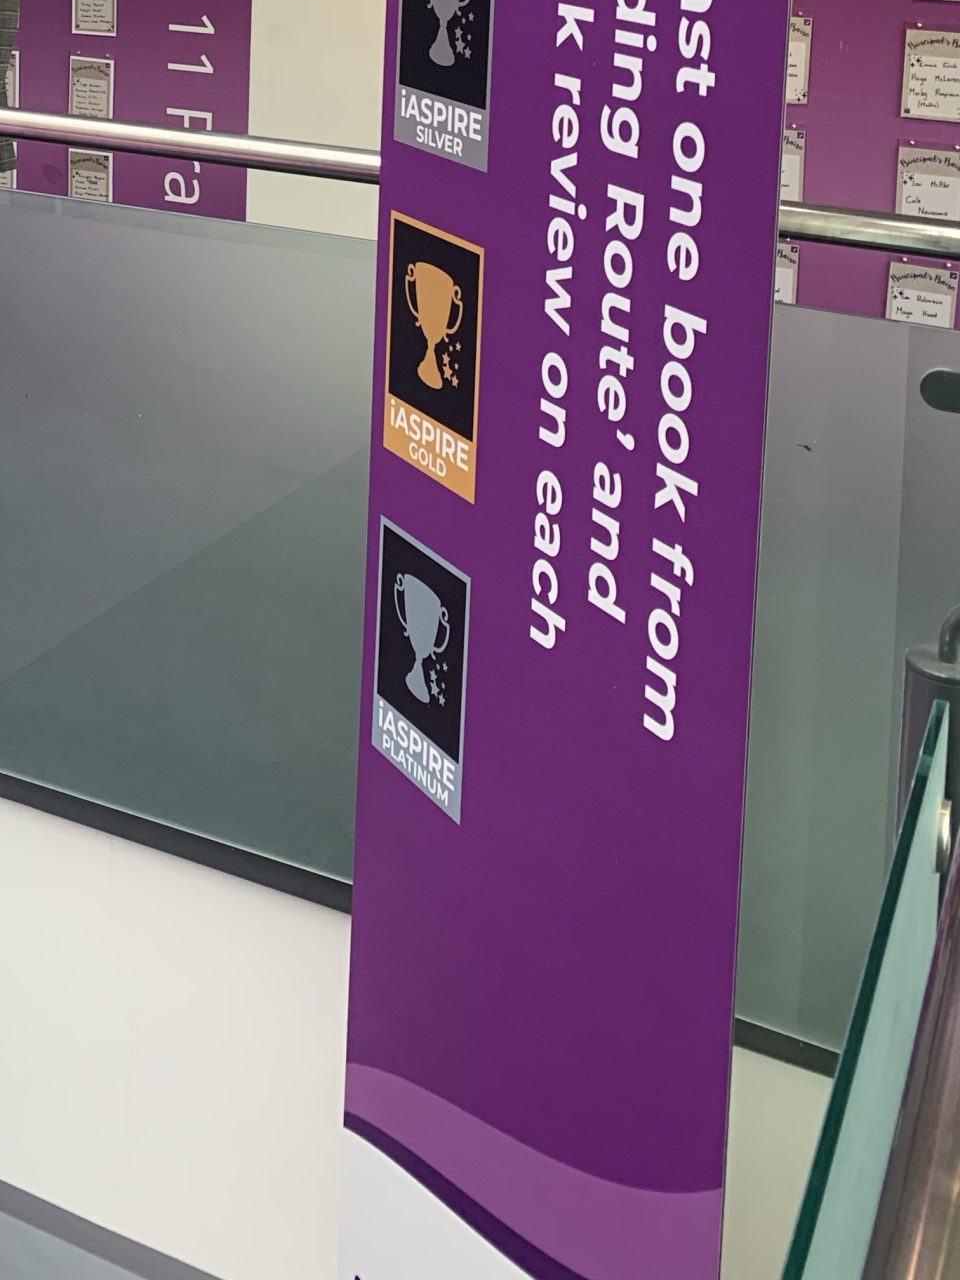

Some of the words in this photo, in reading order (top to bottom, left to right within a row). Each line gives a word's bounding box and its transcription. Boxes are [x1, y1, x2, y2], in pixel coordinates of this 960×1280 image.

[167, 14, 216, 75] 11
[400, 89, 482, 142] iASPIRE
[416, 125, 463, 157] SILVER
[545, 72, 587, 337] review
[667, 122, 705, 281] one
[598, 183, 645, 451] Route’
[389, 398, 470, 472] iASPIRE
[539, 351, 568, 448] on
[655, 304, 708, 523] book
[408, 441, 447, 478] GOLD
[529, 470, 566, 649] each
[588, 461, 626, 624] and
[643, 537, 694, 741] from
[378, 700, 456, 792] iASPIRE
[382, 733, 449, 807] PLATINUM
